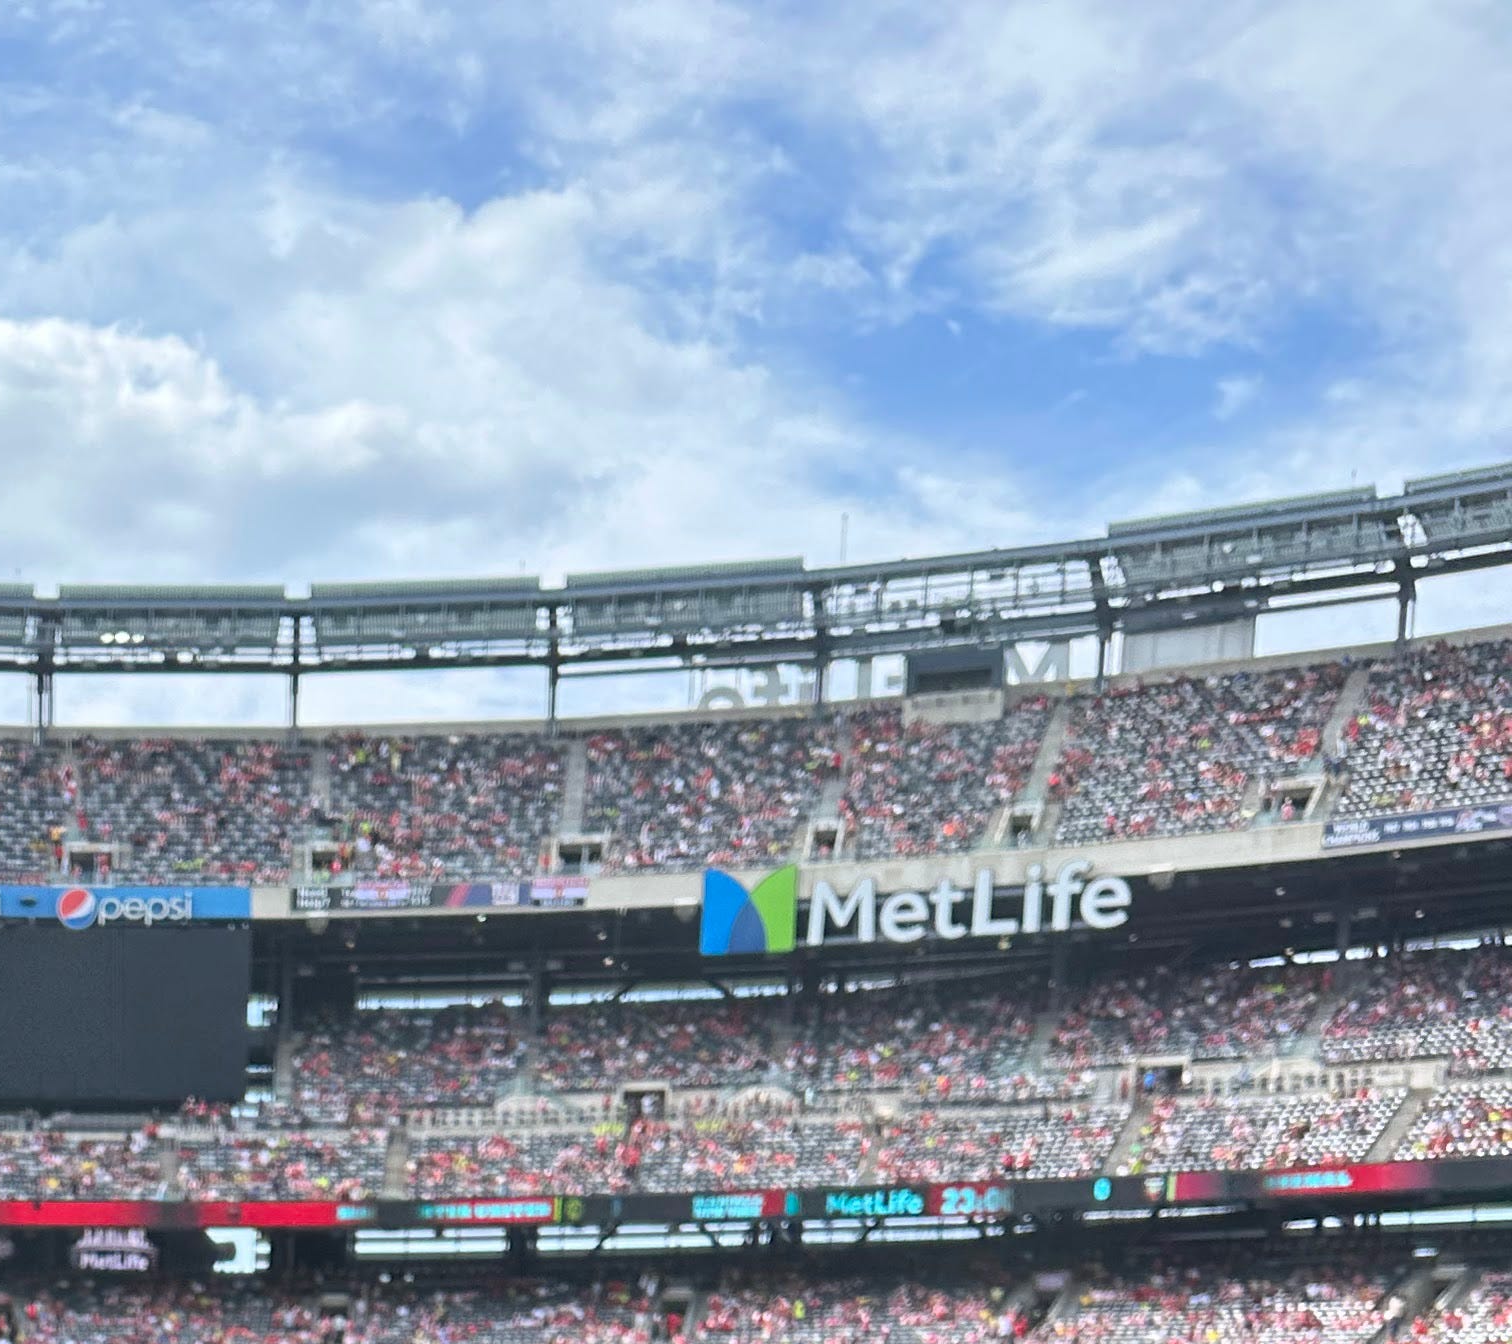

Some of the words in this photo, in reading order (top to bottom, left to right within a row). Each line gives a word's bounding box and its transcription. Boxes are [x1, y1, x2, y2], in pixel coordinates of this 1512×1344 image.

[97, 891, 192, 926] pepsi
[807, 859, 1133, 946] MetLife
[825, 1188, 925, 1217] MetLife
